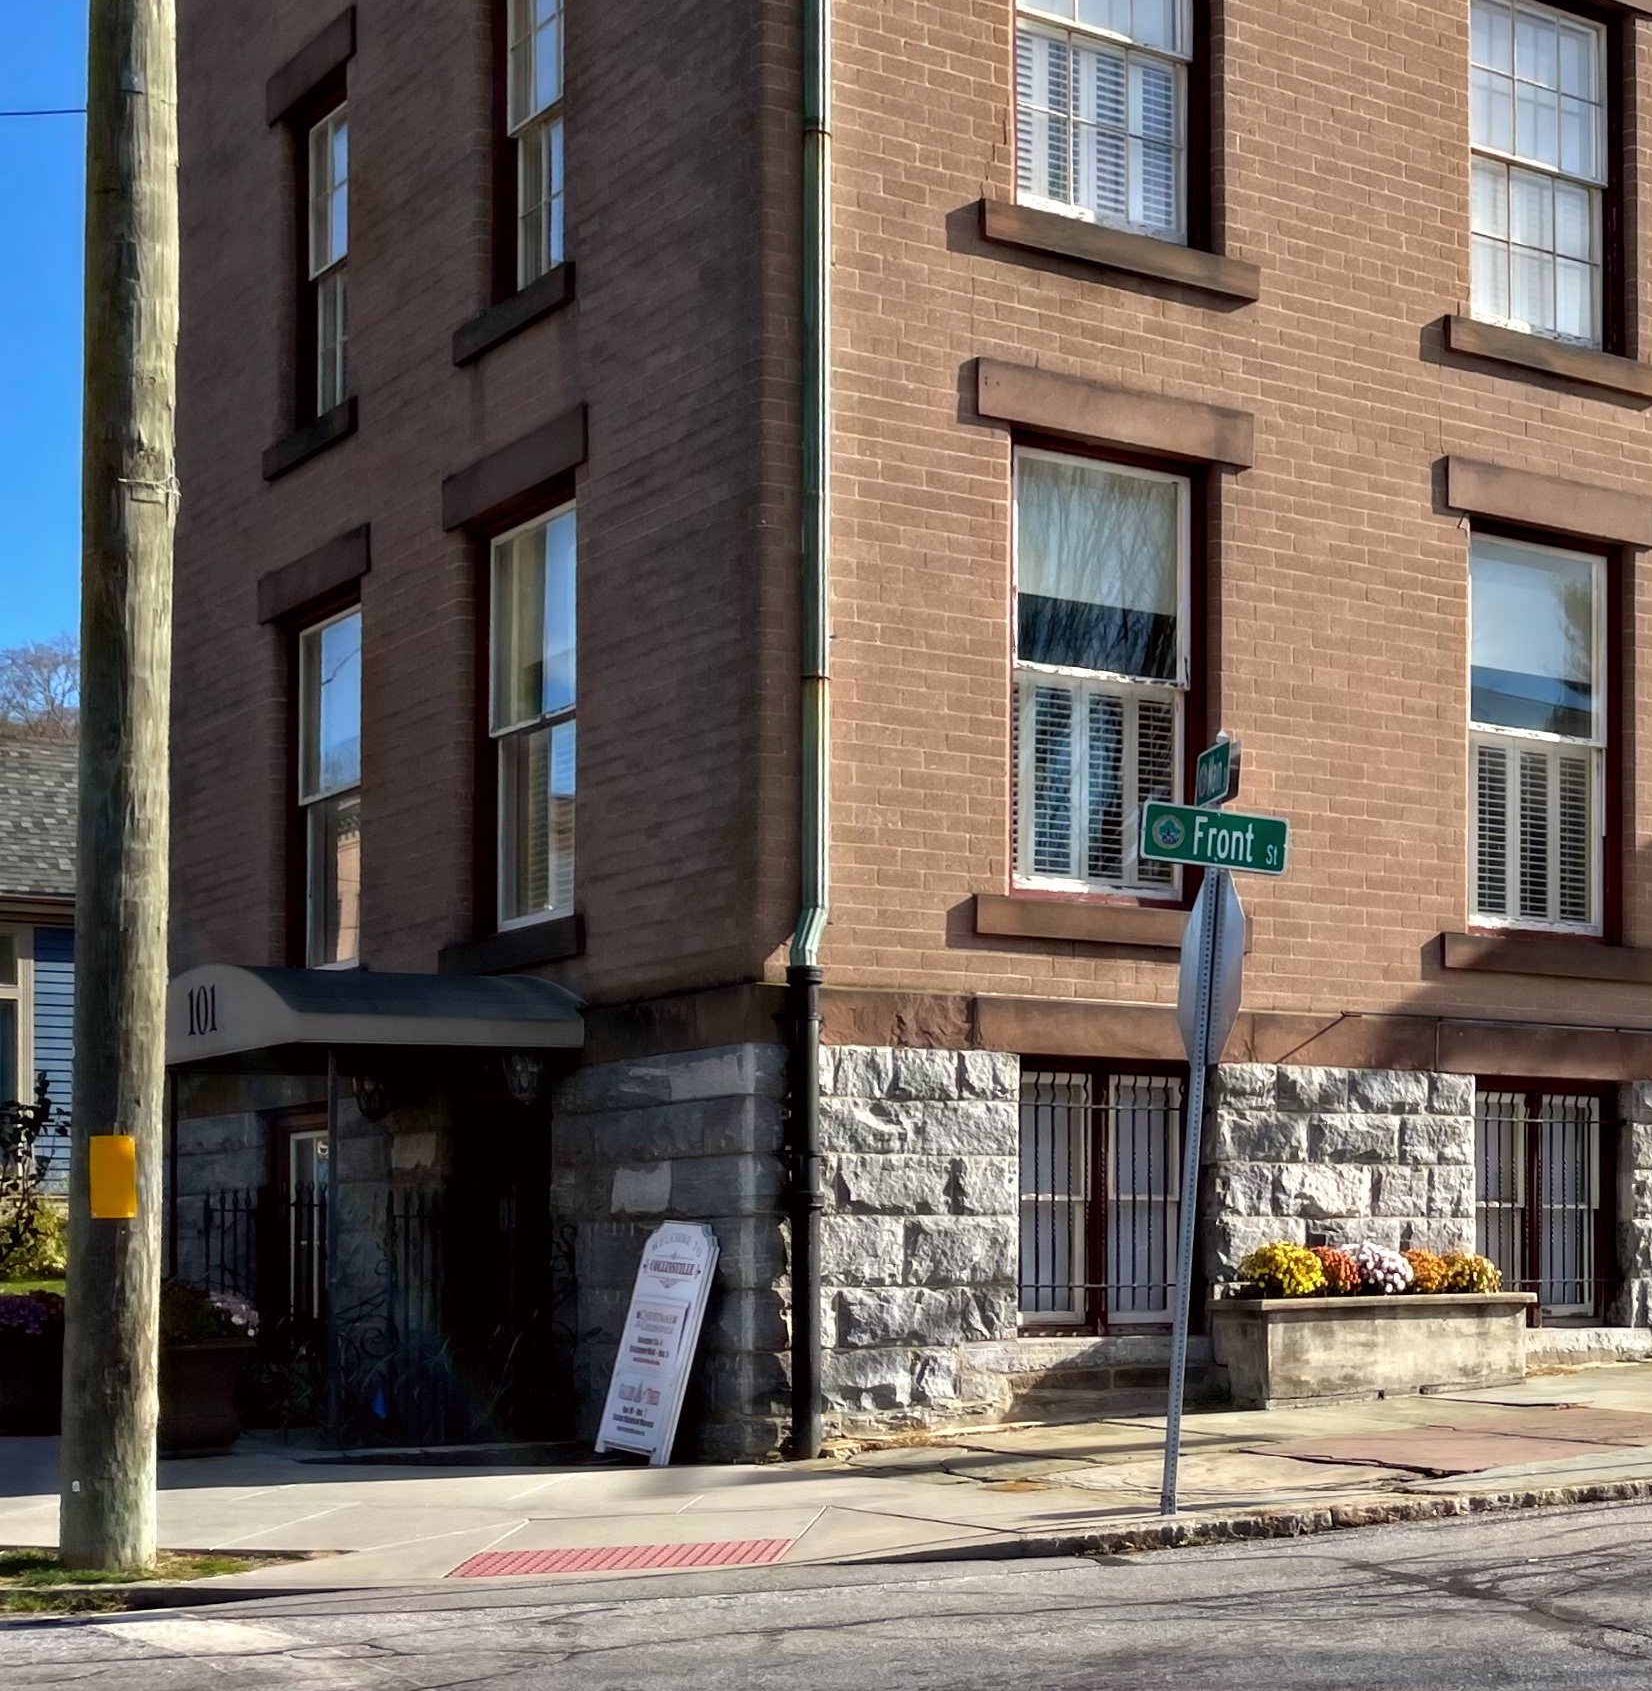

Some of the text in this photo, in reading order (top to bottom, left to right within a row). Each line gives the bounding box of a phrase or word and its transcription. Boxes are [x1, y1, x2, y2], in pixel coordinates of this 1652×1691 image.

[1192, 815, 1278, 866] Front St
[187, 984, 218, 1036] 101
[651, 1232, 703, 1258] WELCOME TO
[649, 1259, 696, 1276] COLLINSVILLE
